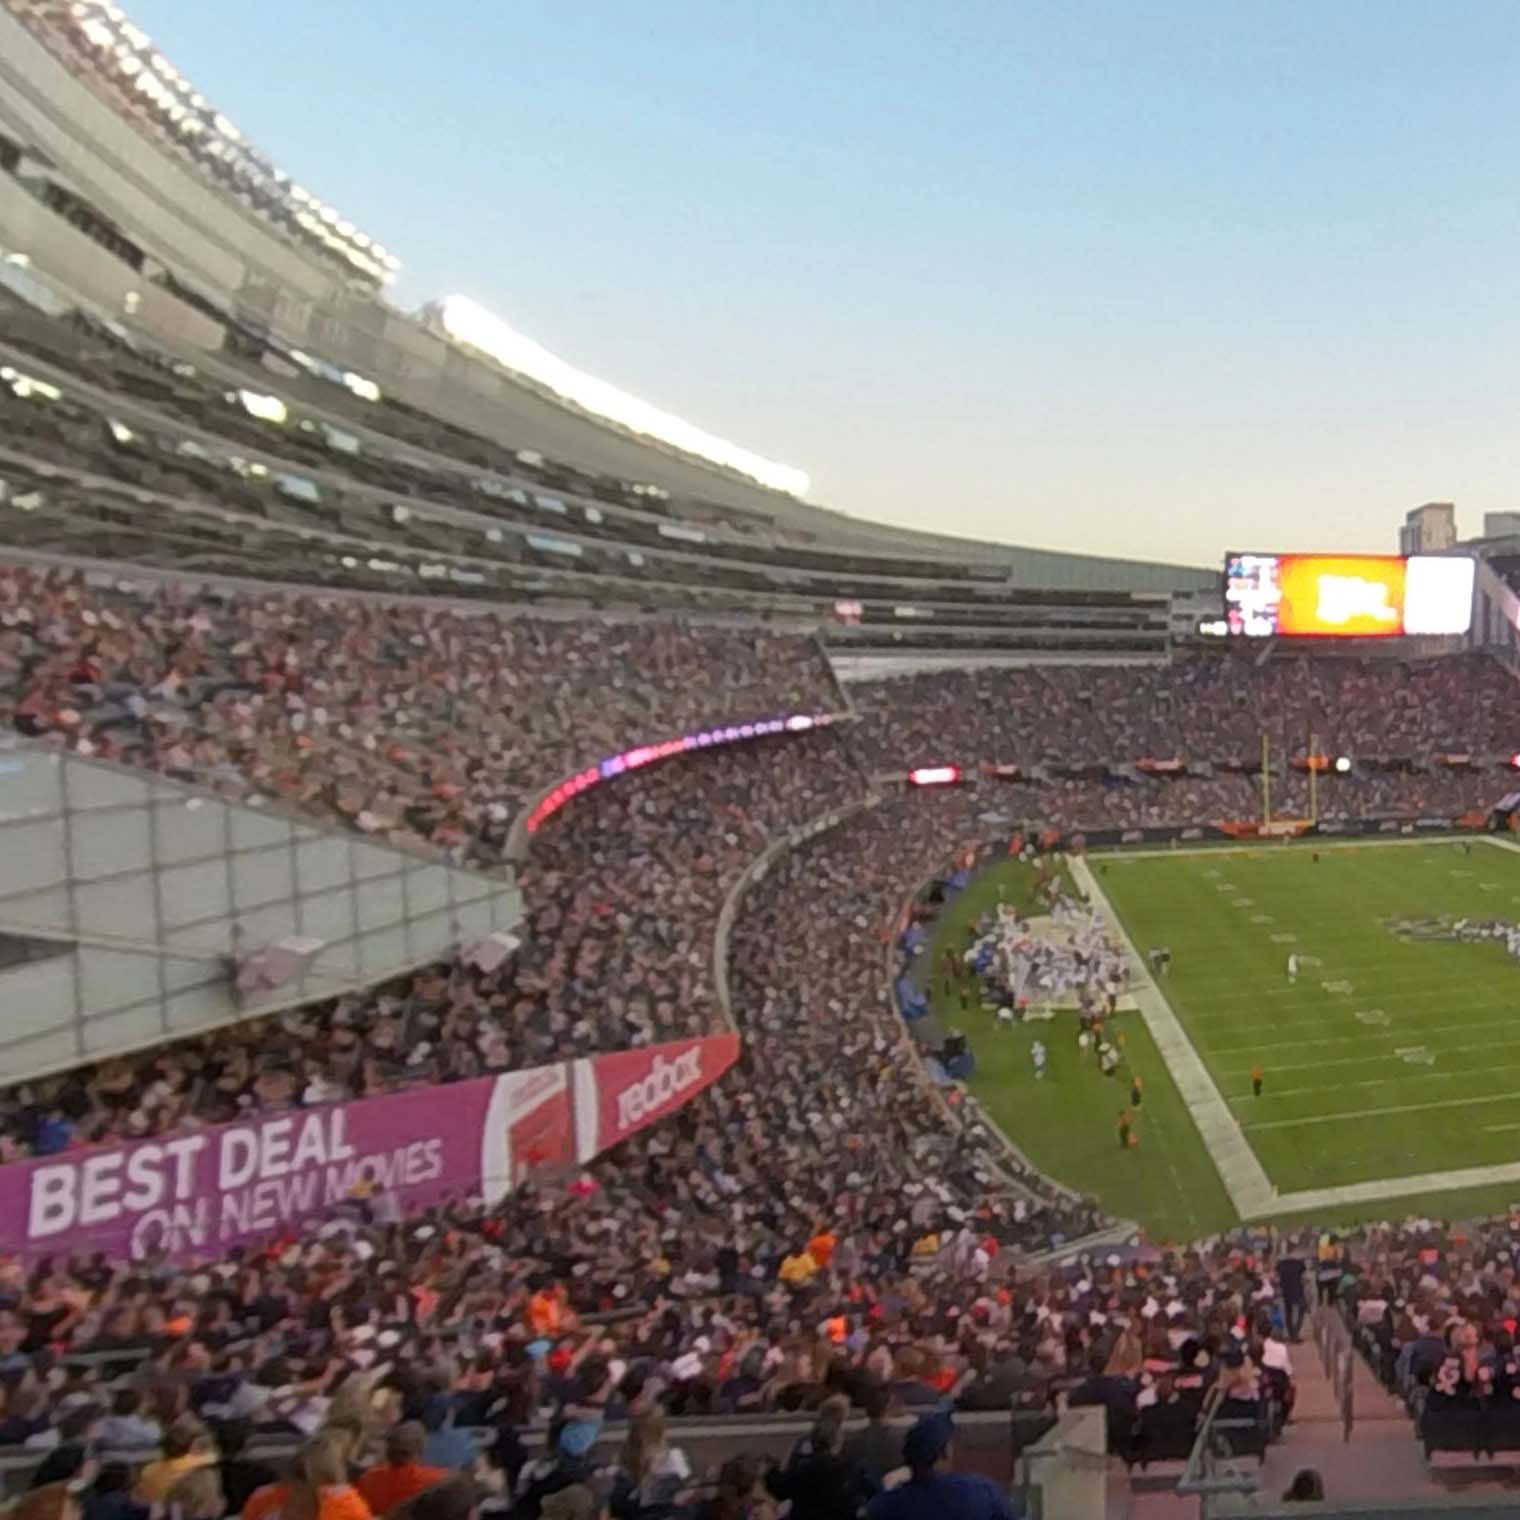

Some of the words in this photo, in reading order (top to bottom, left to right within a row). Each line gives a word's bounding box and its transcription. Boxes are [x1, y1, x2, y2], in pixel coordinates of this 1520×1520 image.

[617, 1046, 701, 1130] redbox
[27, 1135, 207, 1239] BEST
[218, 1108, 355, 1191] DEAL
[131, 1197, 208, 1260] ON
[219, 1169, 318, 1242] NEW
[323, 1138, 444, 1206] MOVIES
